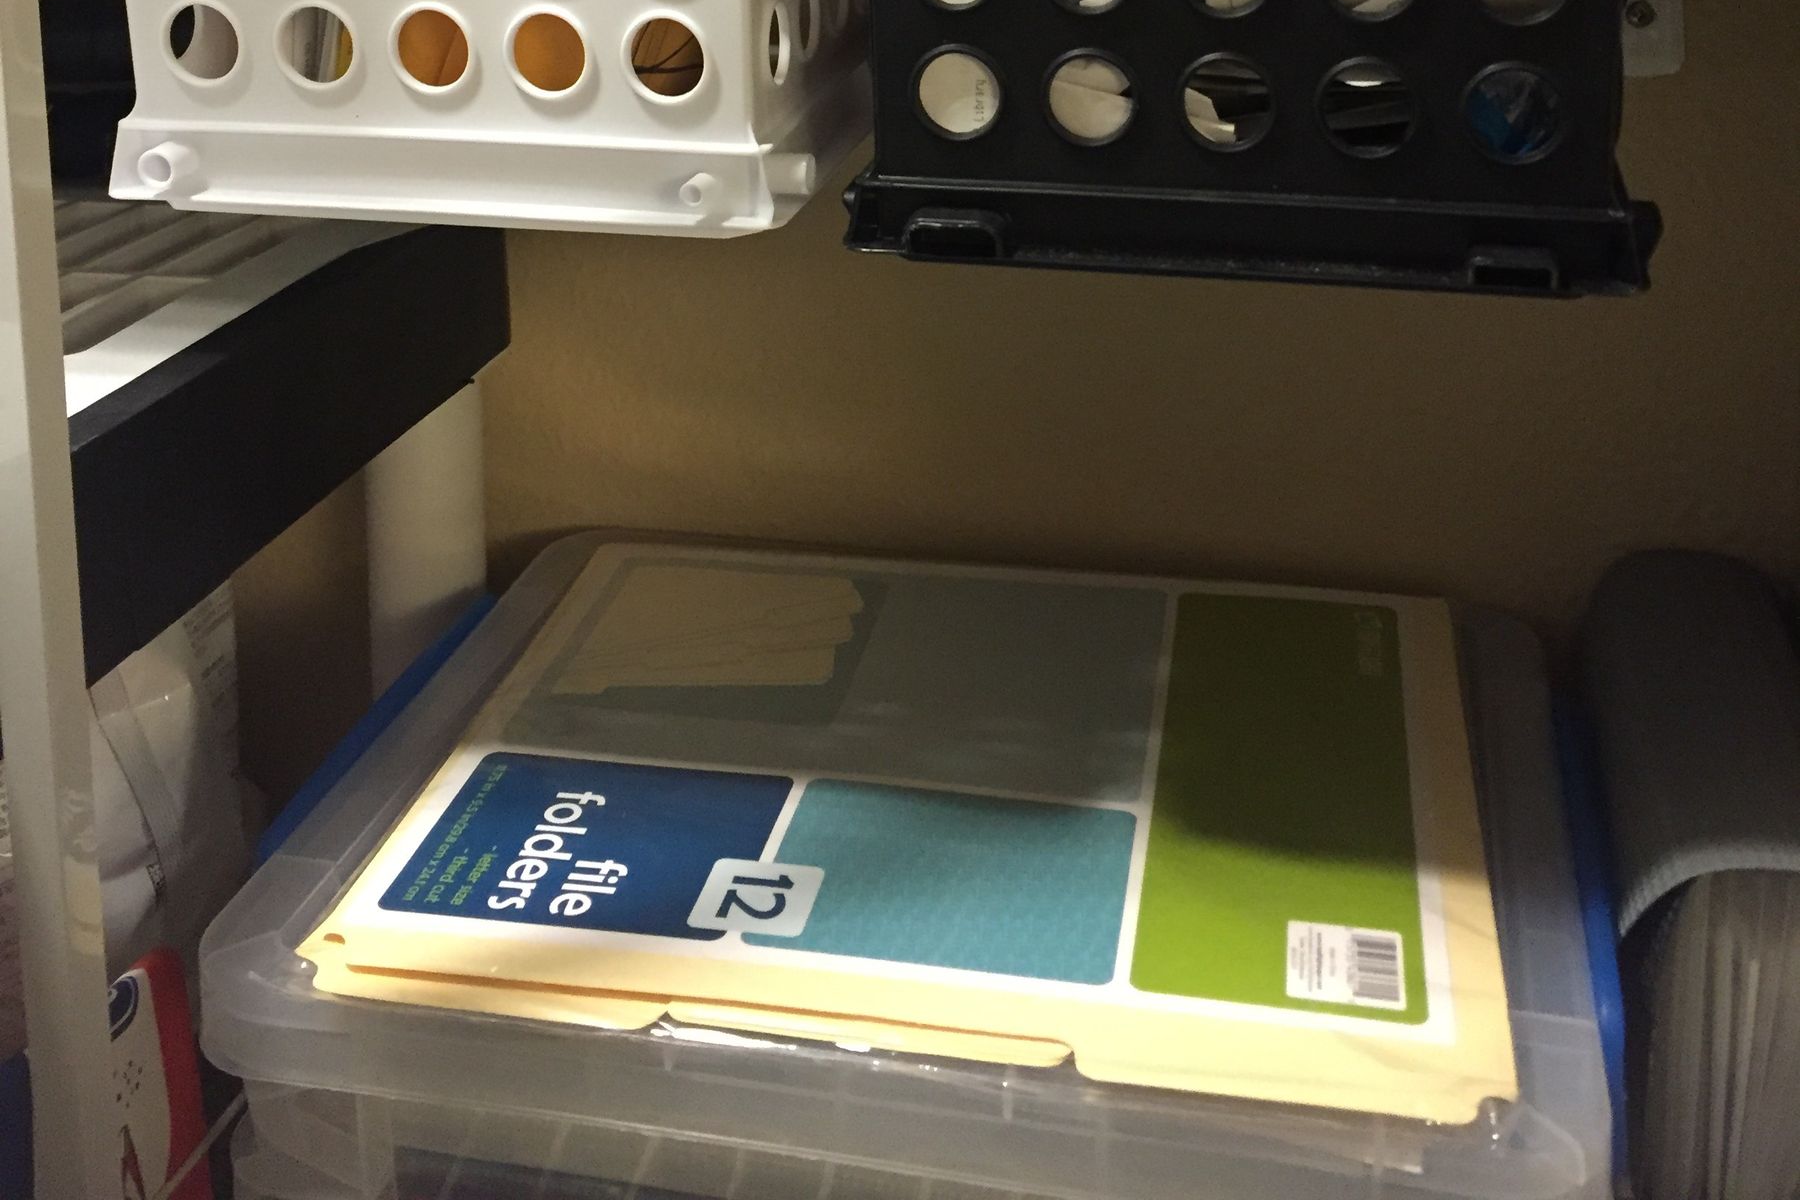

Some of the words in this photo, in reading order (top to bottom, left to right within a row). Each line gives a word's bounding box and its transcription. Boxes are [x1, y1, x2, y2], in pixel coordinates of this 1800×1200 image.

[487, 792, 606, 909] folders
[440, 855, 469, 883] third
[467, 853, 498, 884] letter
[424, 884, 445, 904] cut
[451, 884, 473, 906] size
[549, 860, 628, 916] file
[715, 874, 795, 919] 12
